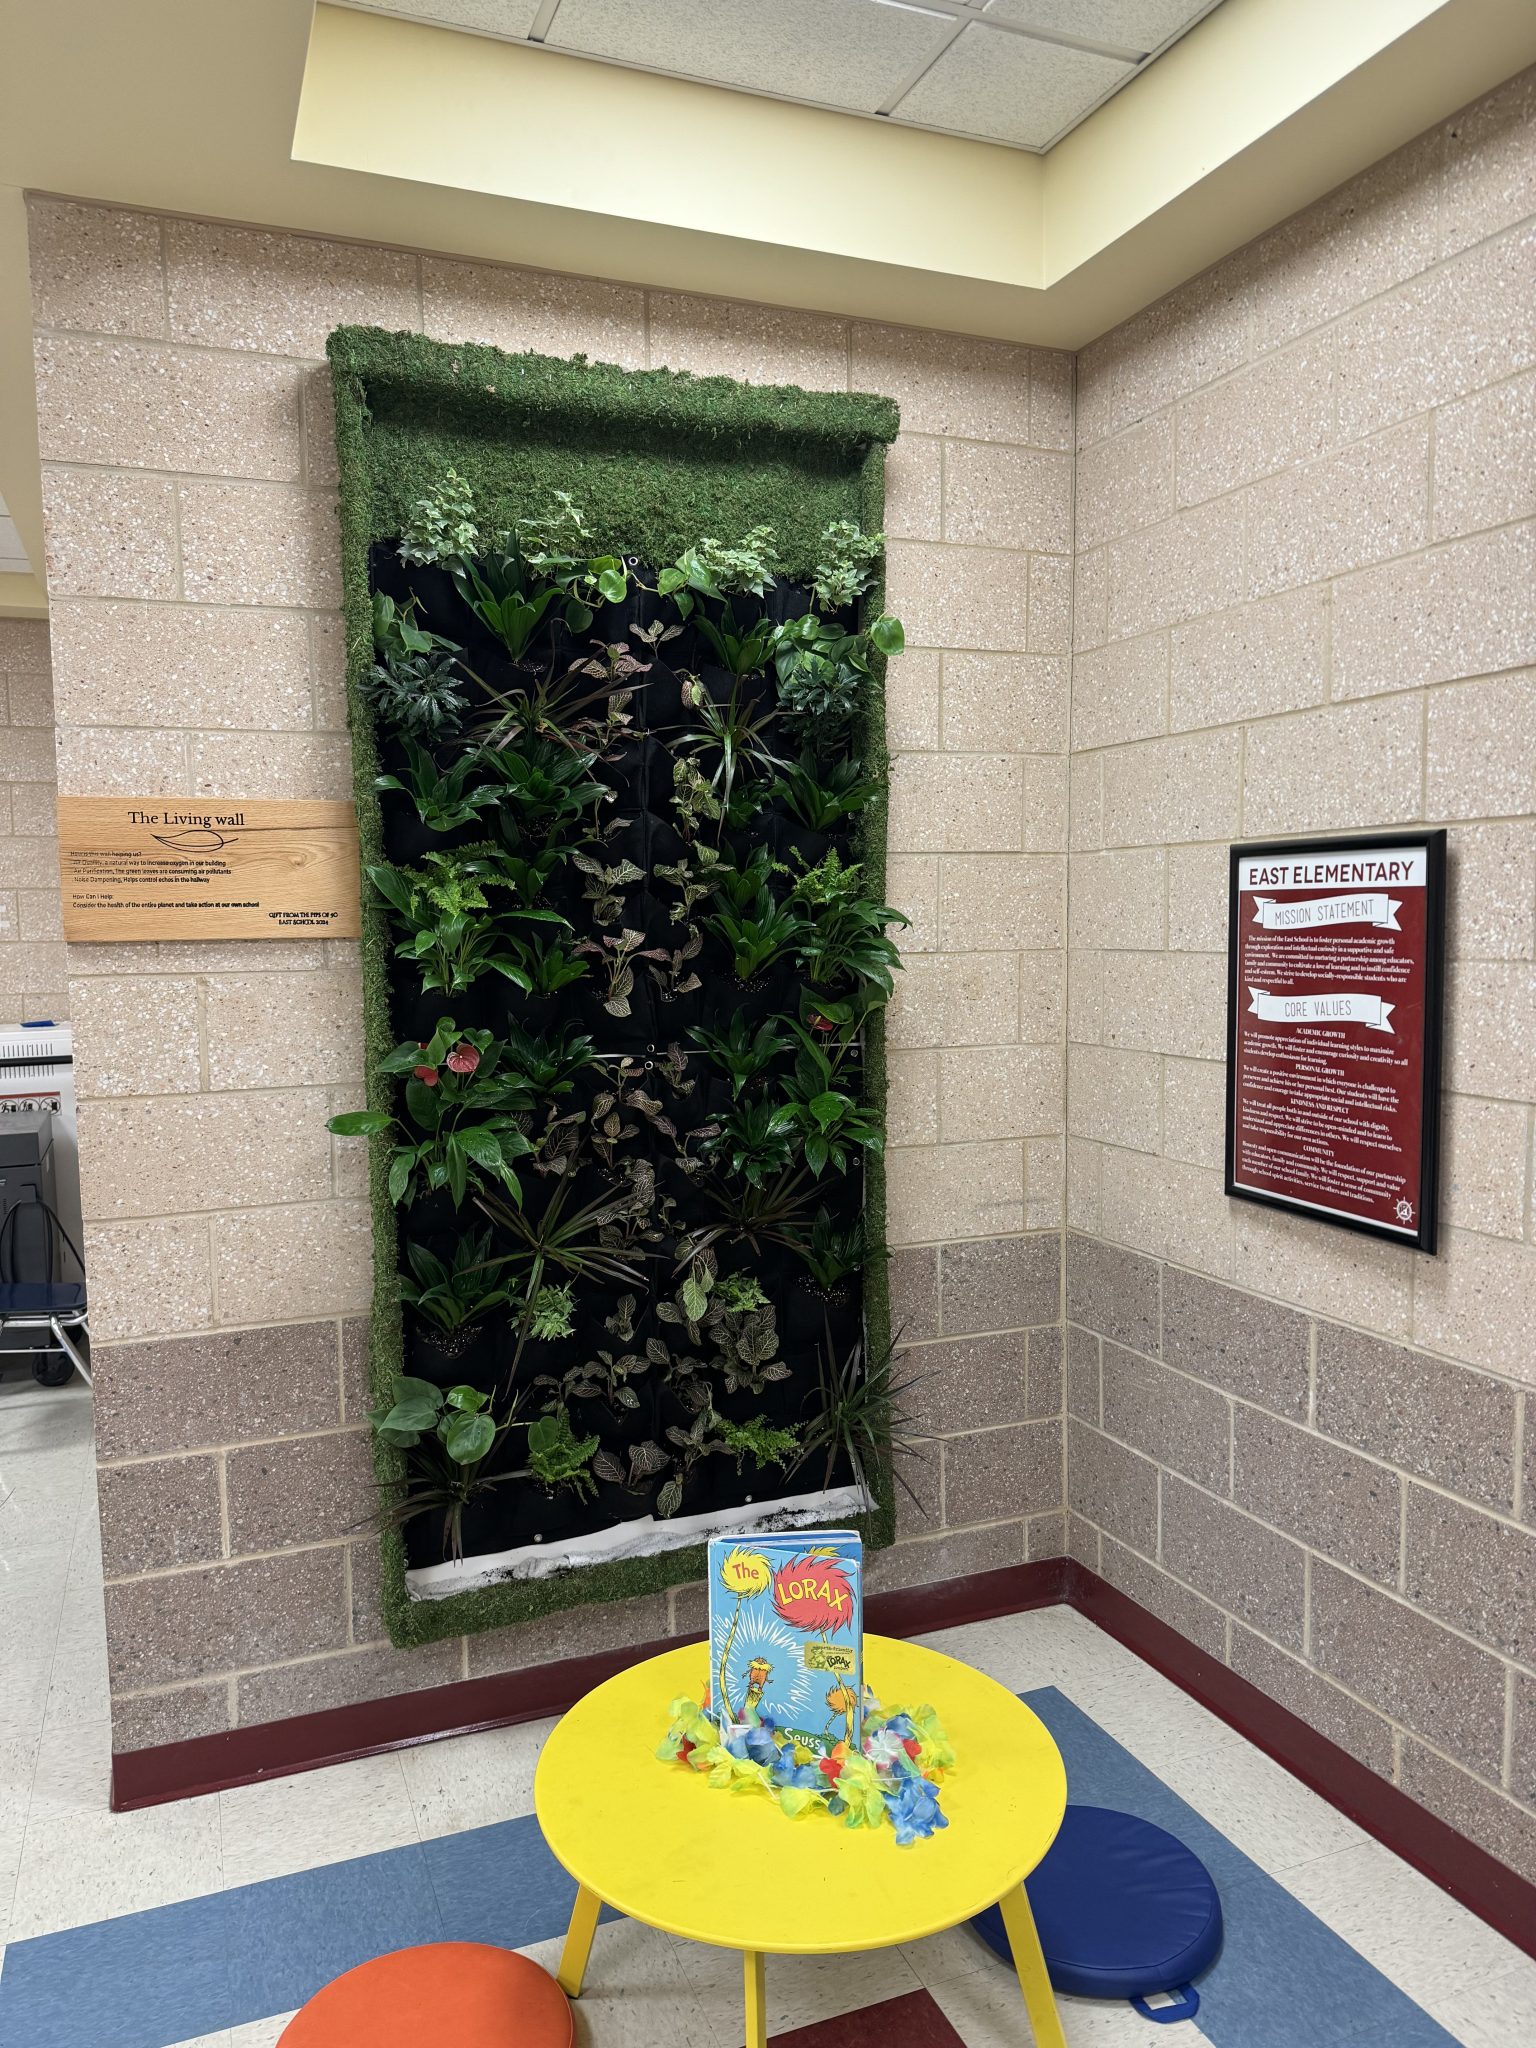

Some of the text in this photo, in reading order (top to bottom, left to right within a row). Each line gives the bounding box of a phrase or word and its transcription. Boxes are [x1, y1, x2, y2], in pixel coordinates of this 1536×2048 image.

[128, 812, 245, 828] The Living wall
[1249, 861, 1414, 885] EAST ELEMENTARY
[1275, 899, 1374, 926] MISSION STATEMENT
[1333, 937, 1353, 945] personal
[1377, 938, 1395, 946] growth
[1318, 946, 1337, 954] curiosity
[1347, 946, 1372, 955] supportive
[1315, 954, 1336, 962] nurturing
[1341, 955, 1368, 964] partnership
[1266, 960, 1288, 969] community
[1331, 963, 1350, 972] learning
[1262, 977, 1282, 985] respectful
[1300, 971, 1317, 979] develop
[1318, 972, 1363, 982] socially-responsible
[1284, 1000, 1352, 1017] CORE VALUES
[1296, 1027, 1345, 1038] ACADEMIC GROWTH
[1258, 1033, 1274, 1042] promote
[1275, 1035, 1301, 1045] appreciation
[1307, 1039, 1329, 1047] individual
[1330, 1041, 1349, 1051] learning
[1350, 1044, 1363, 1053] styles
[1370, 1046, 1394, 1055] maximize
[1296, 1063, 1344, 1076] PERSONAL GROWTH
[1291, 1098, 1314, 1108] KINDNESS
[1327, 1104, 1348, 1114] RESPECT
[1303, 1144, 1334, 1157] COMMUNITY
[732, 1562, 759, 1579] The
[777, 1578, 849, 1612] LORAX
[827, 1656, 851, 1668] LORAX
